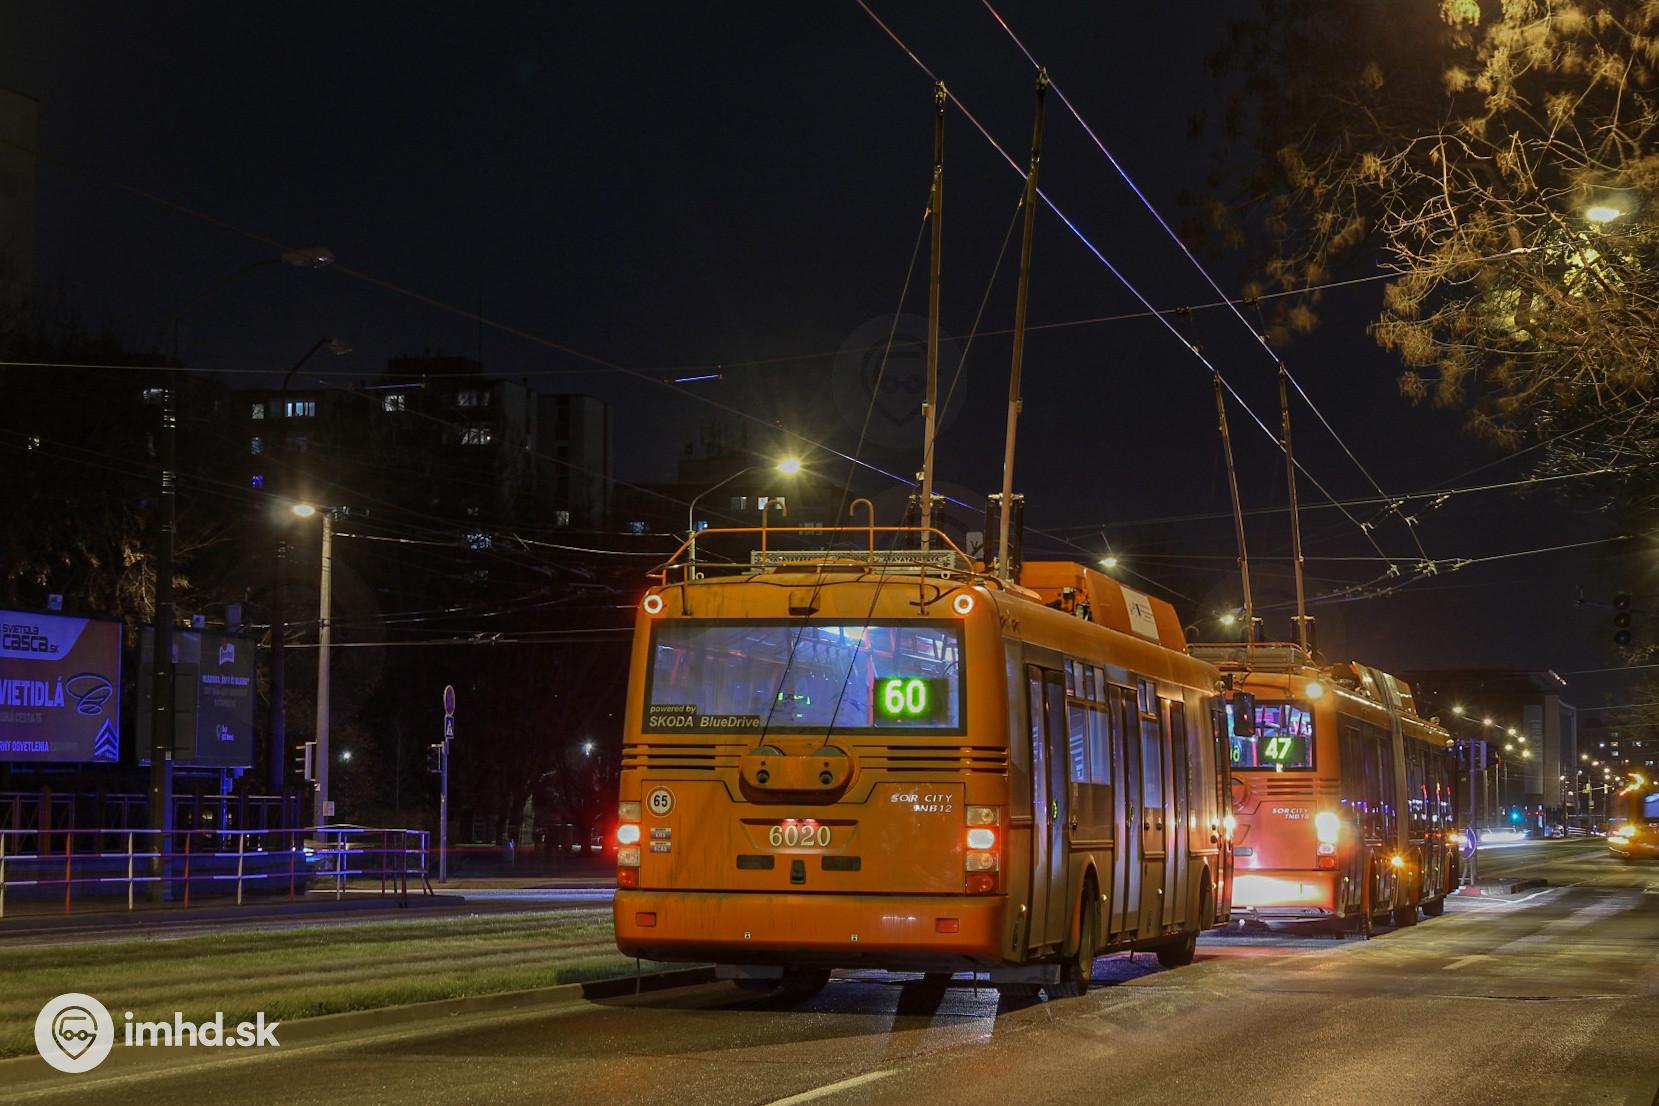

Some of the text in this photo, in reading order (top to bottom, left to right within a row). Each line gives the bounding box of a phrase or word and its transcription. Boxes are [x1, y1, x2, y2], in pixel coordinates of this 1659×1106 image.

[884, 679, 926, 713] 60
[649, 704, 696, 714] powered by
[649, 715, 760, 727] SKODA BlueDrive
[1264, 737, 1292, 759] 47
[653, 794, 668, 808] 65
[890, 794, 953, 803] SOR CITY
[769, 825, 831, 847] 6020
